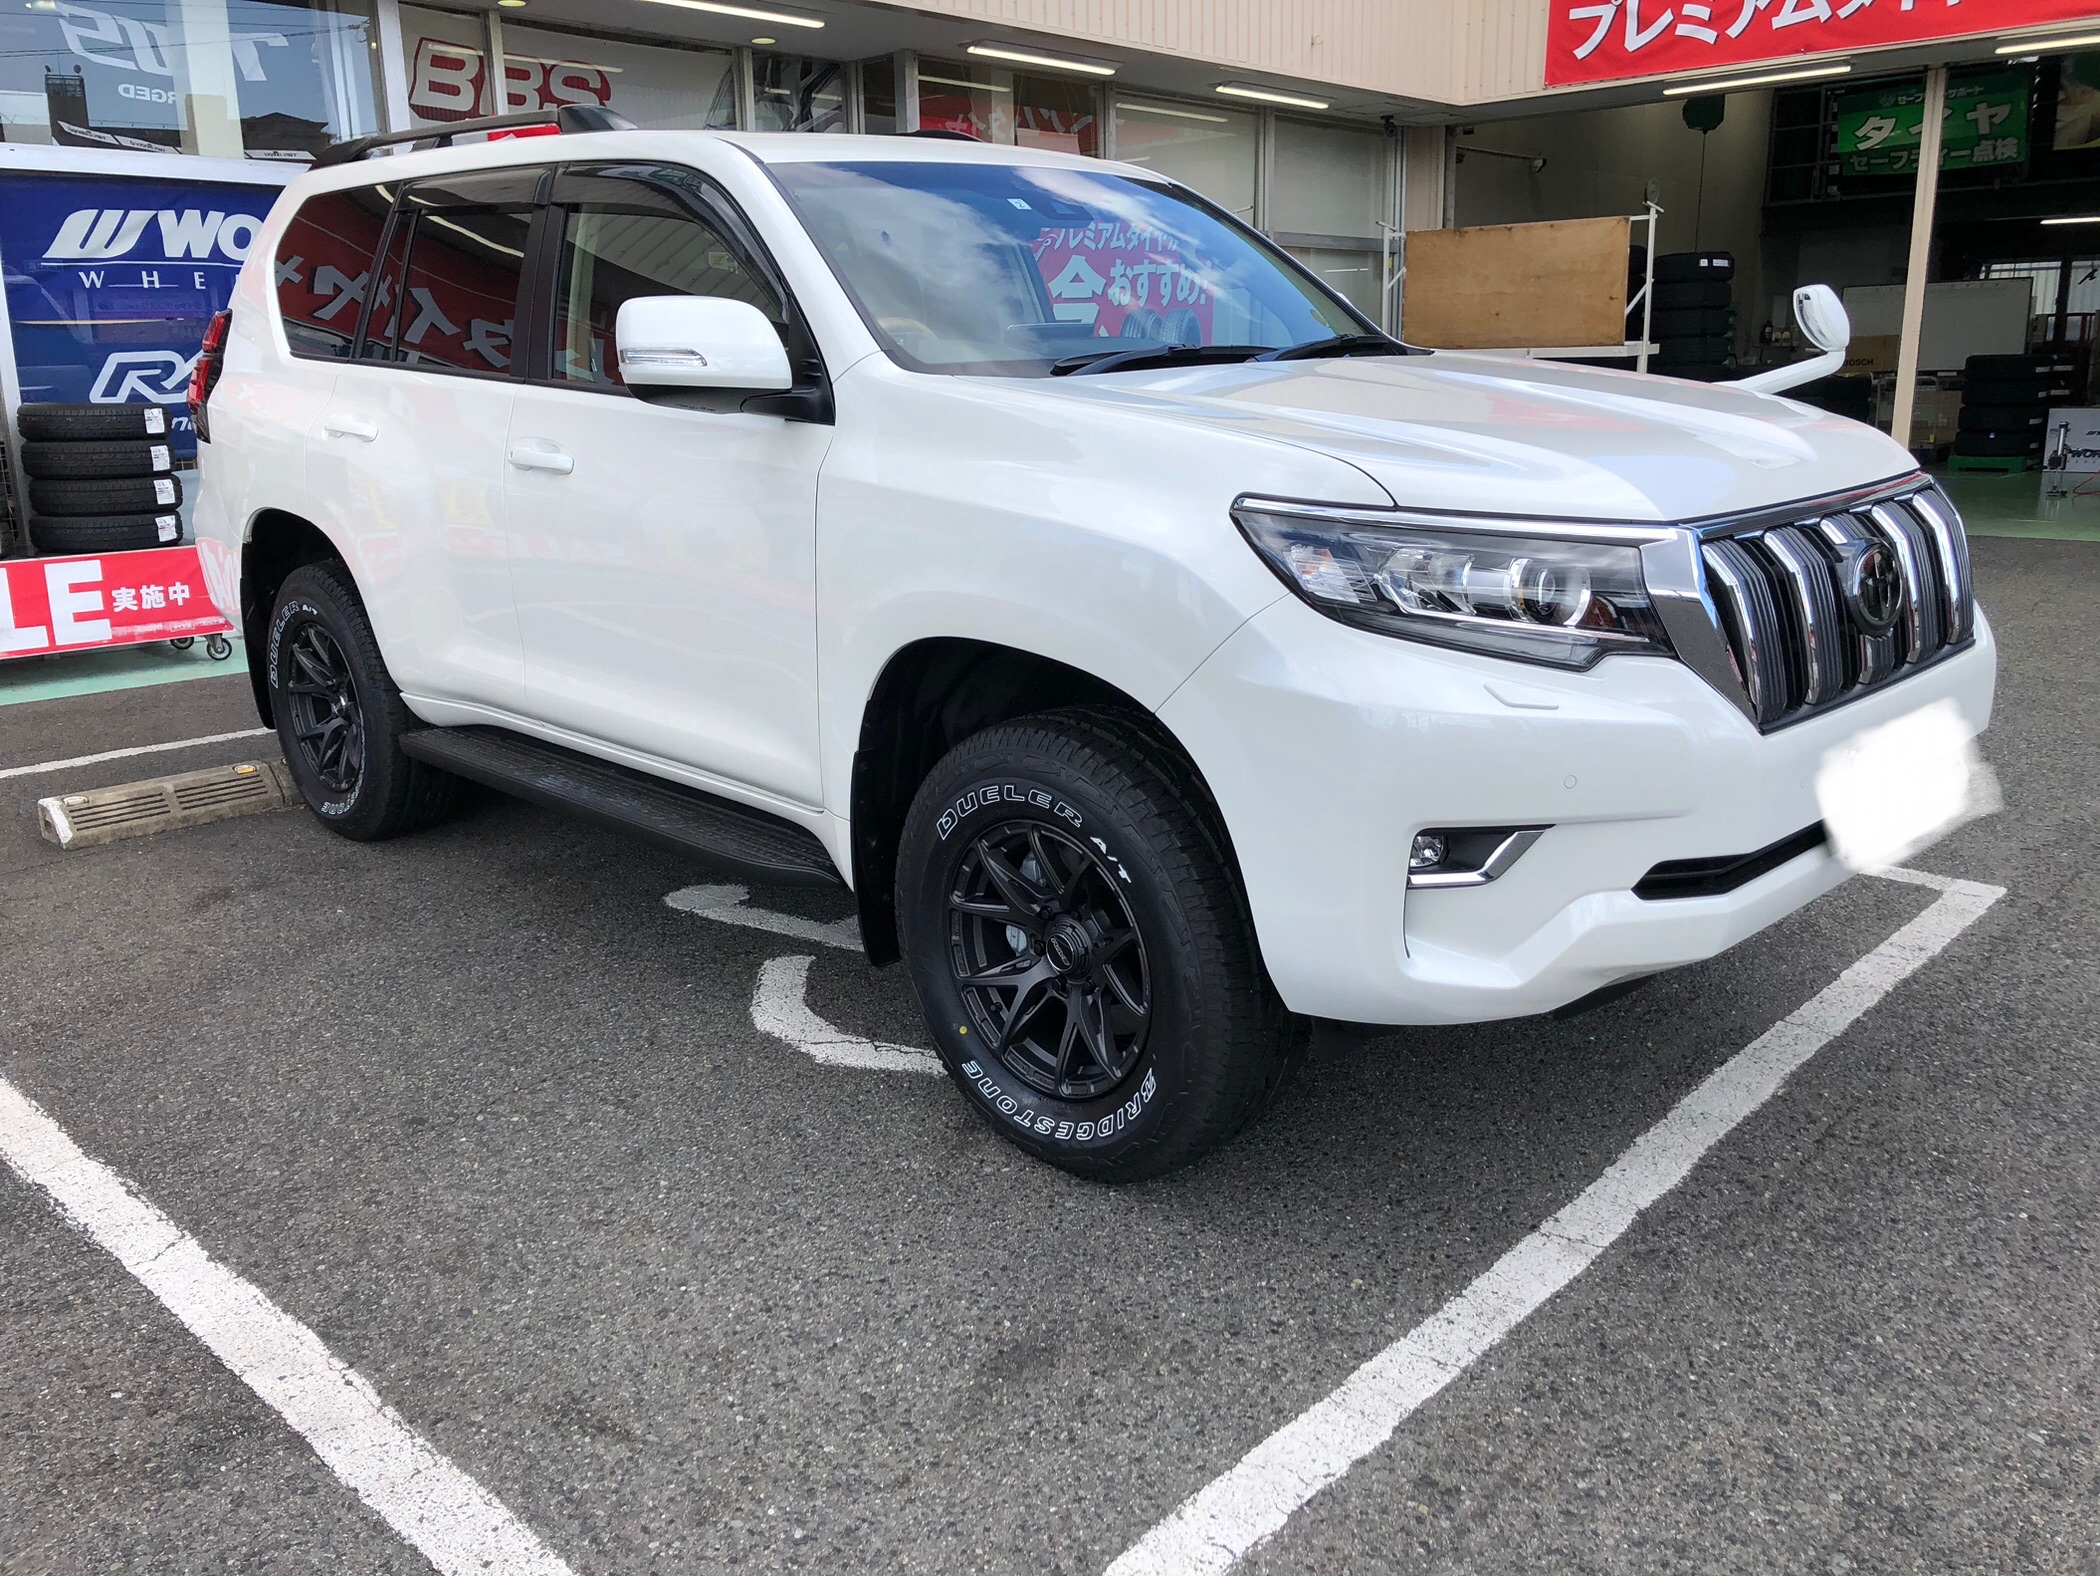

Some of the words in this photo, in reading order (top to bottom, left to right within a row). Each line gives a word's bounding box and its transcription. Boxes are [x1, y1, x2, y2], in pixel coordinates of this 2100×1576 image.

[409, 39, 605, 115] BBS
[1854, 102, 2012, 150] タヤ
[112, 581, 190, 612] 実施中
[270, 600, 300, 689] DUELER
[936, 785, 1083, 841] DUELER
[961, 1060, 1157, 1140] BRIDGESTONE
